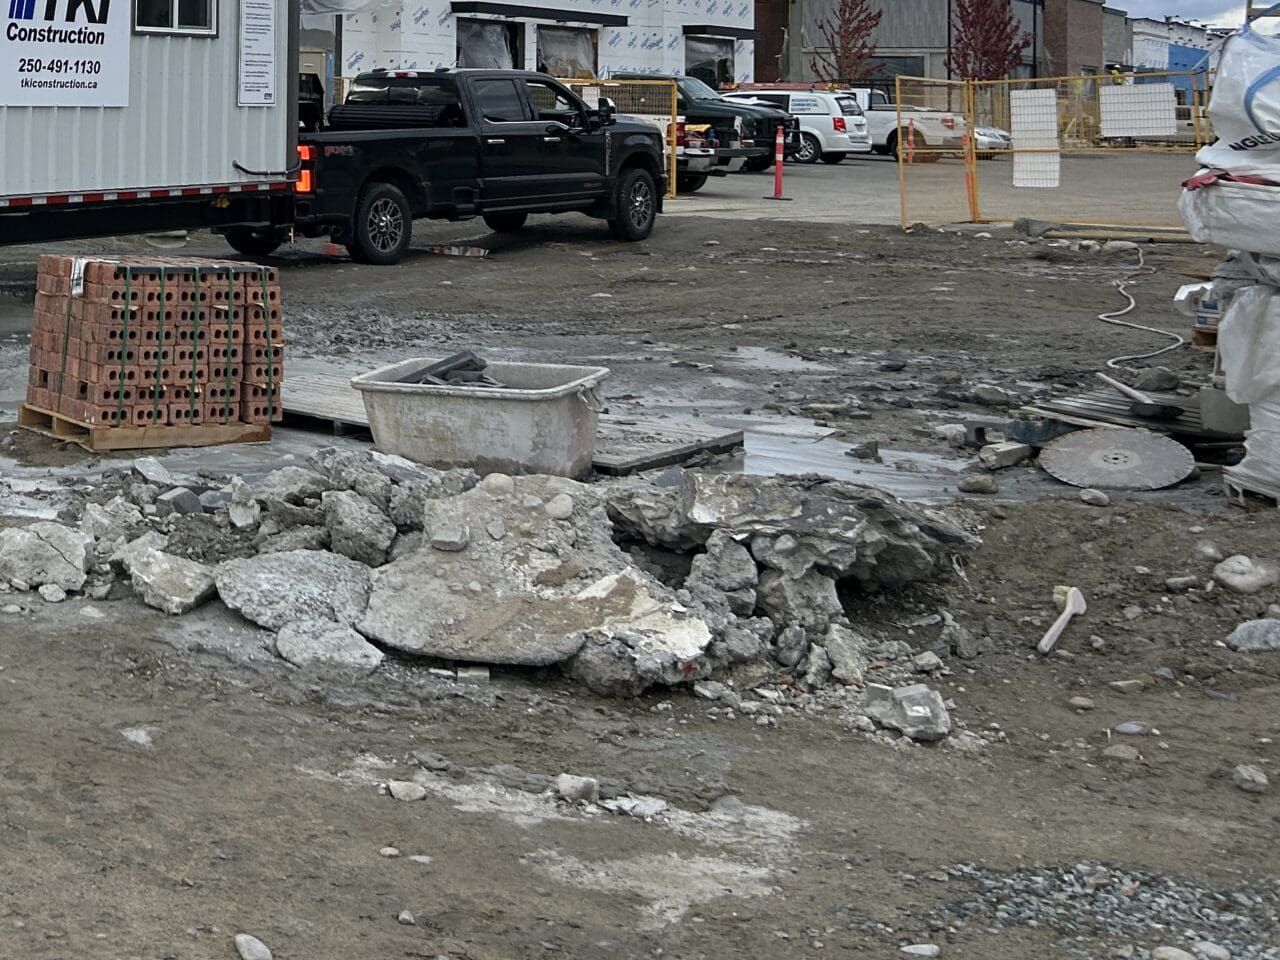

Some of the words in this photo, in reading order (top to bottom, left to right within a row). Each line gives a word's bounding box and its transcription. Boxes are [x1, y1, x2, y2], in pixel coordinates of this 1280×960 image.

[6, 22, 105, 45] Construction
[18, 58, 101, 74] 250-491-1130
[20, 78, 98, 89] tkiconstruction.ca
